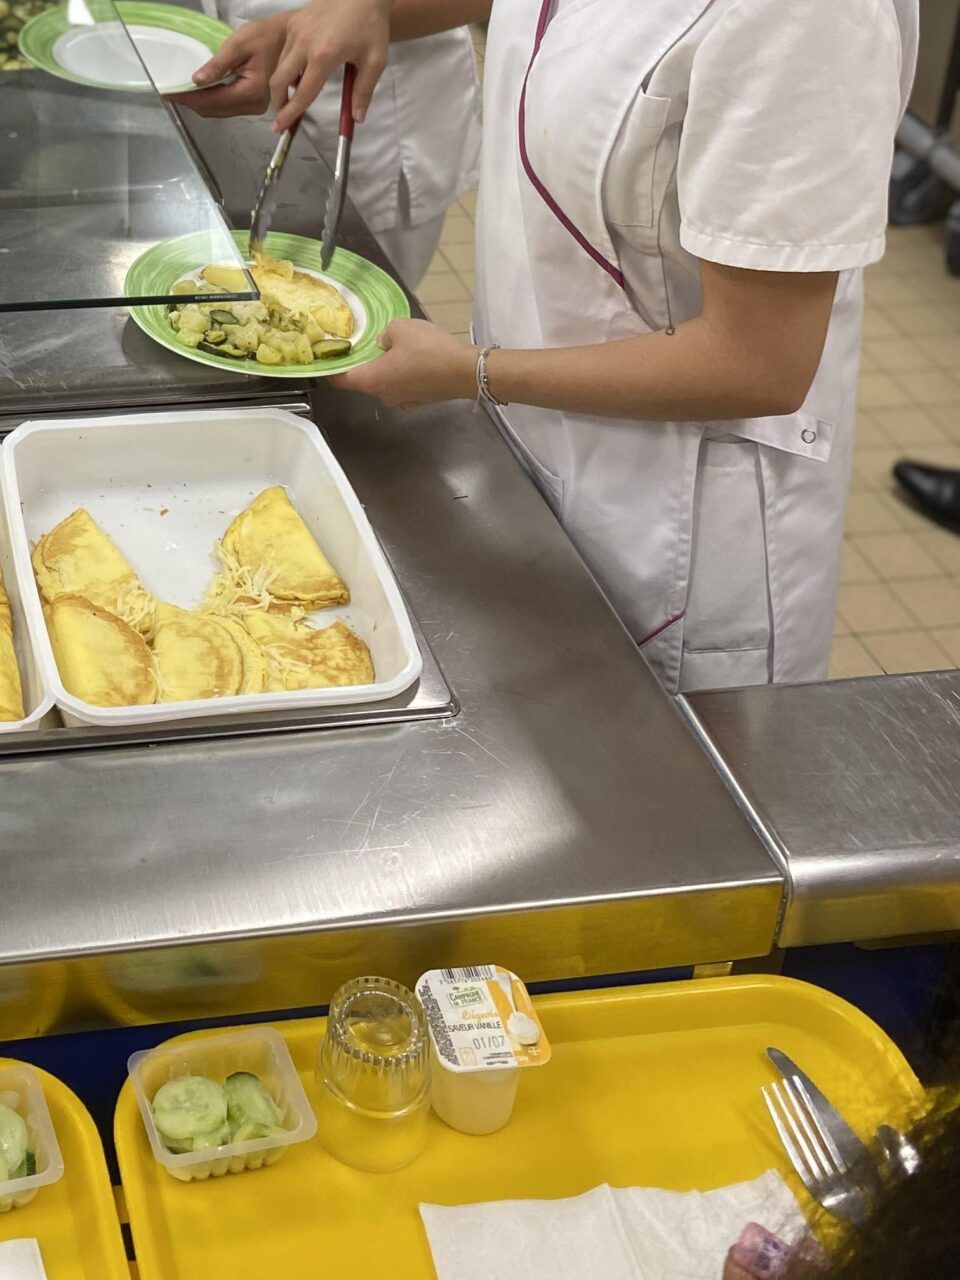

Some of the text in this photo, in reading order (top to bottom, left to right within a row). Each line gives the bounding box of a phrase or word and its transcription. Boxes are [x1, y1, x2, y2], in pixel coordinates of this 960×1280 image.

[447, 1021, 502, 1032] SAVEUR VANILLE
[472, 1035, 505, 1050] 01/07
